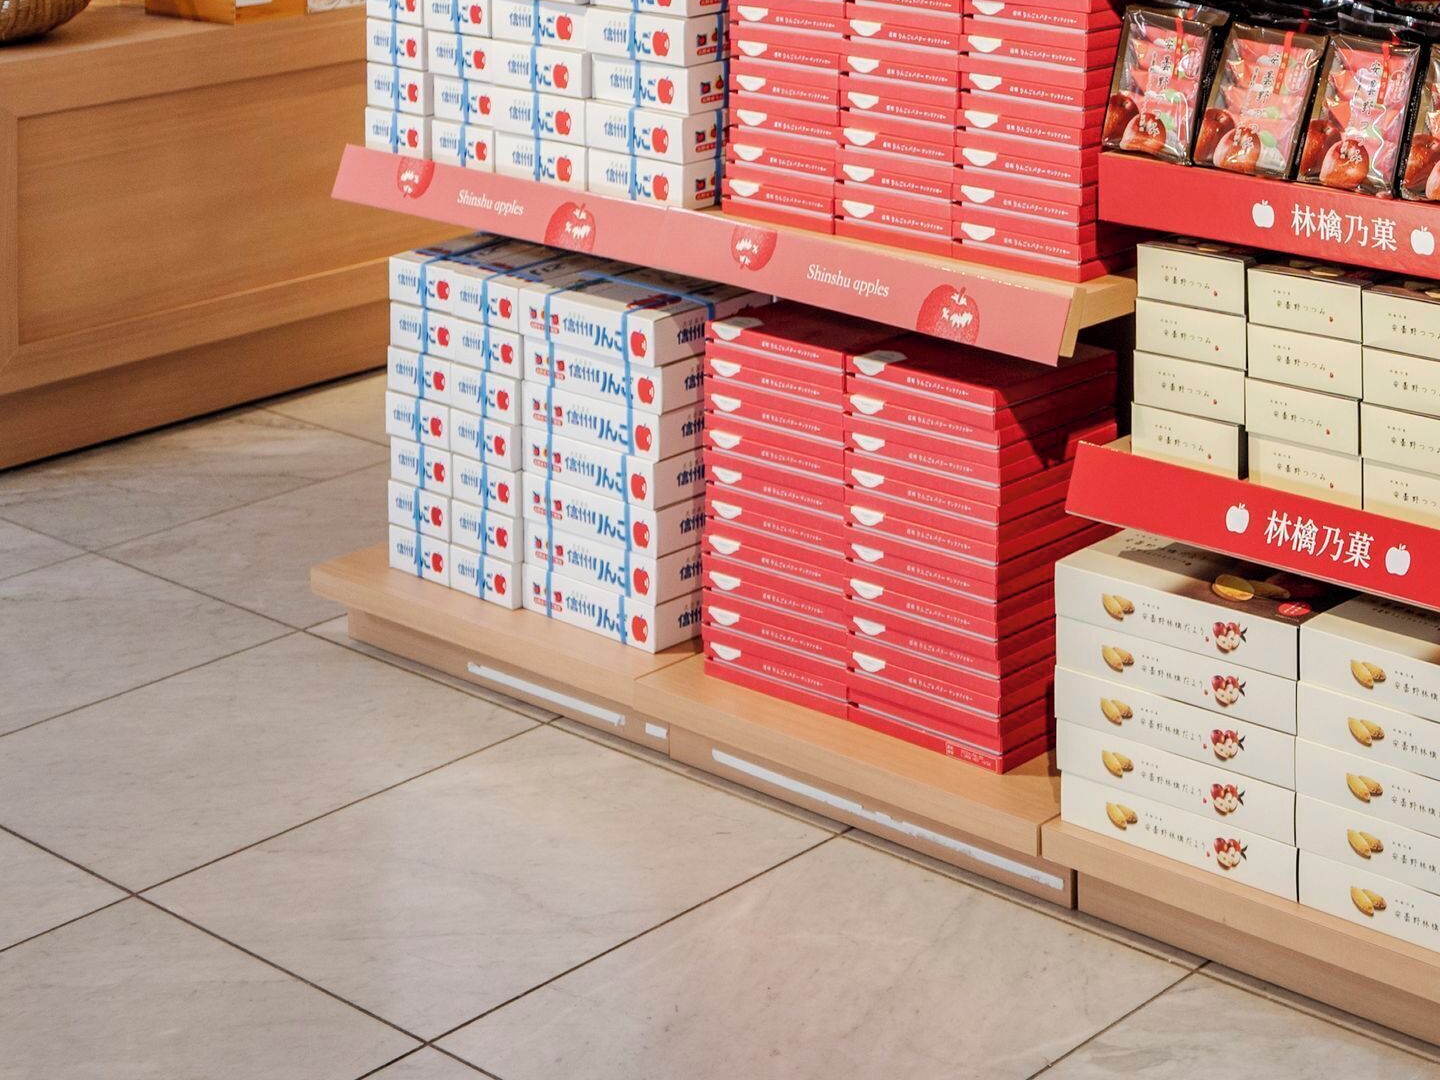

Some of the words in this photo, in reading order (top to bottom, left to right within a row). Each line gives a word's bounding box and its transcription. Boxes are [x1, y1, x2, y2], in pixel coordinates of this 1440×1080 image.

[457, 189, 493, 209] Shinshu
[495, 199, 525, 216] apples
[1291, 202, 1397, 252] 林檎乃菓
[806, 262, 851, 288] Shinshu
[853, 278, 890, 298] apples
[1264, 509, 1373, 568] 林檎乃菓
